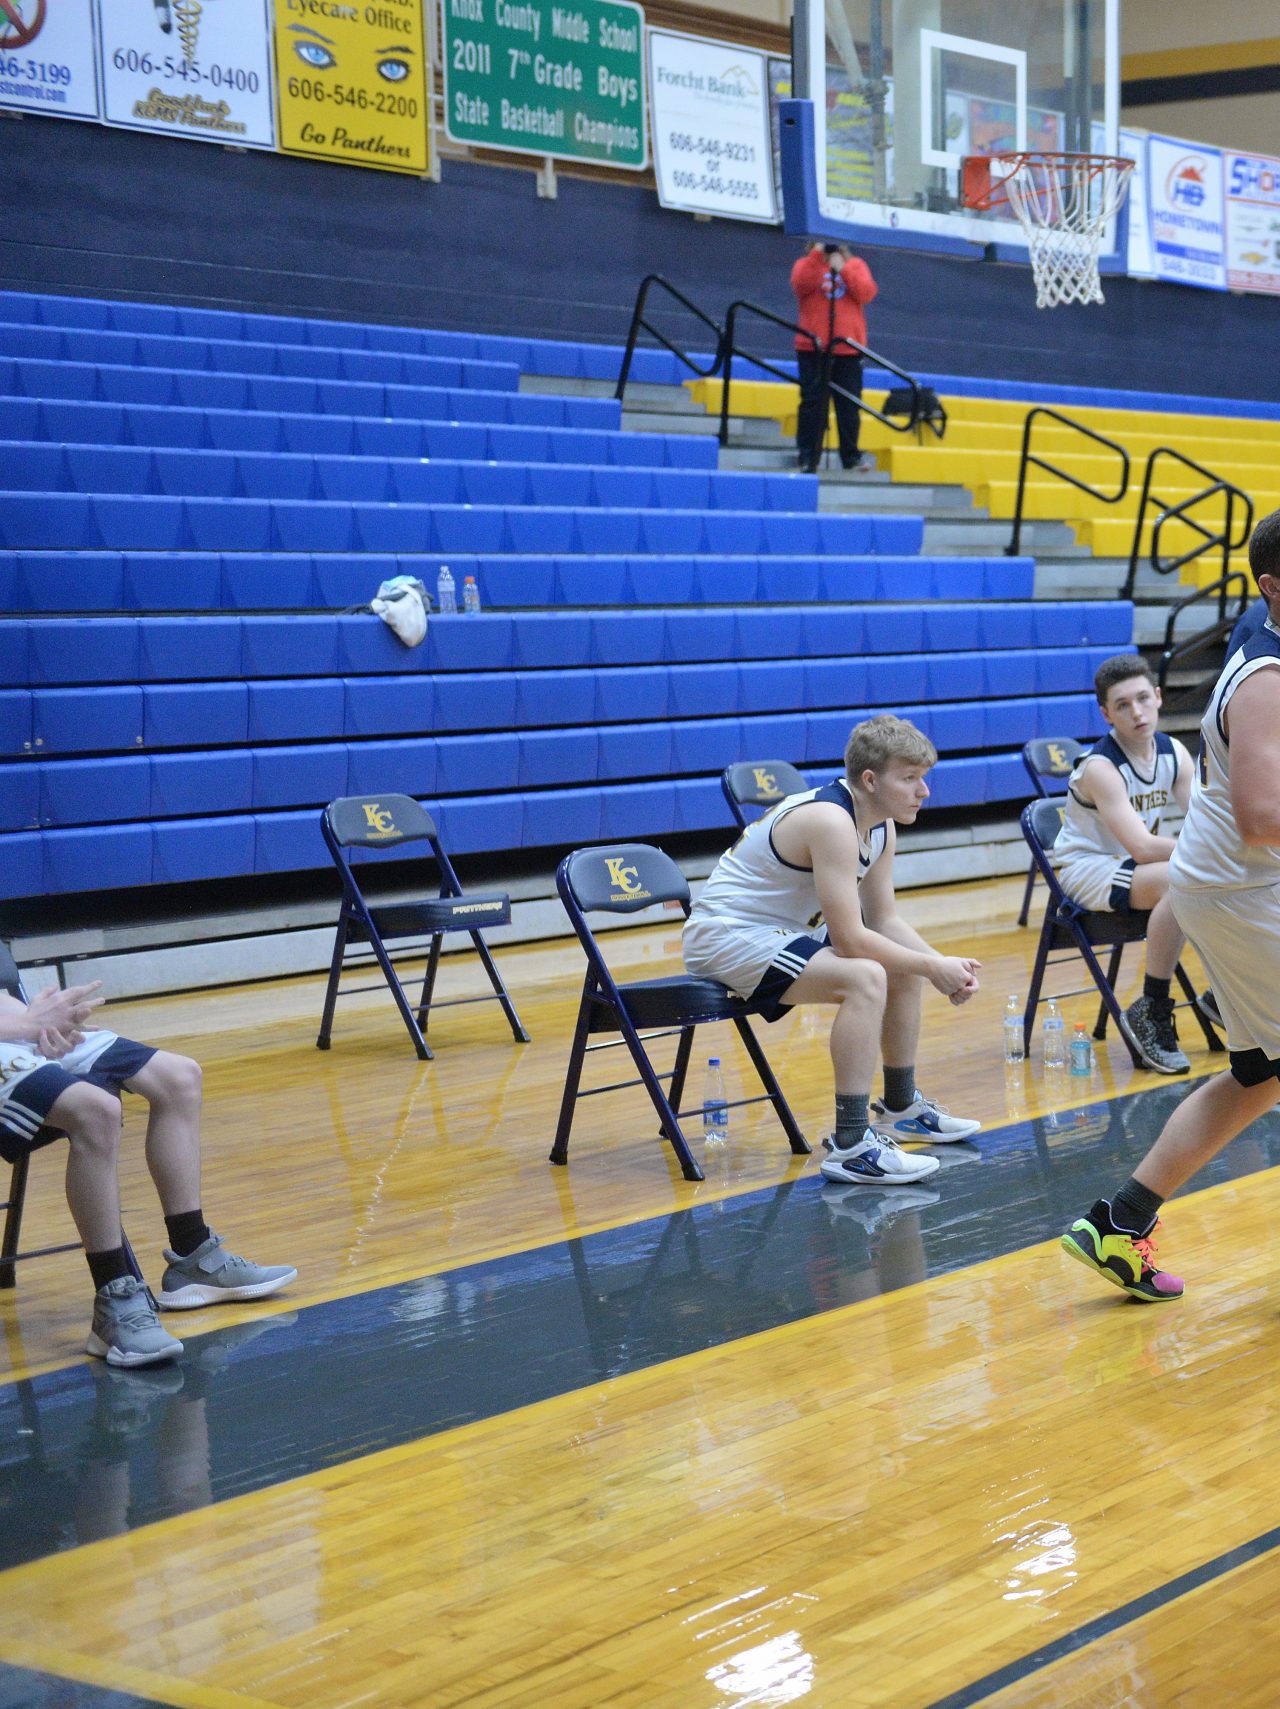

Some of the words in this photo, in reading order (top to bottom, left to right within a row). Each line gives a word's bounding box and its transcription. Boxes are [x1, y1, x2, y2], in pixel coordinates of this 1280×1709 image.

[365, 6, 411, 34] Office
[496, 0, 541, 41] County
[552, 7, 590, 44] Middle
[599, 17, 638, 53] School
[113, 48, 259, 94] 606-545-0400
[453, 38, 491, 75] 2011
[507, 48, 531, 79] 7th
[534, 54, 583, 91] Grade
[598, 66, 638, 108] Boys
[657, 66, 704, 91] Forcht
[708, 76, 746, 98] Bank
[288, 77, 417, 119] 606-546-2200
[300, 122, 326, 144] Go
[331, 127, 411, 158] Panthers
[455, 91, 490, 126] State
[501, 98, 564, 138] Basketball
[574, 111, 639, 154] Champions
[362, 803, 395, 833] KC
[604, 857, 642, 894] KC
